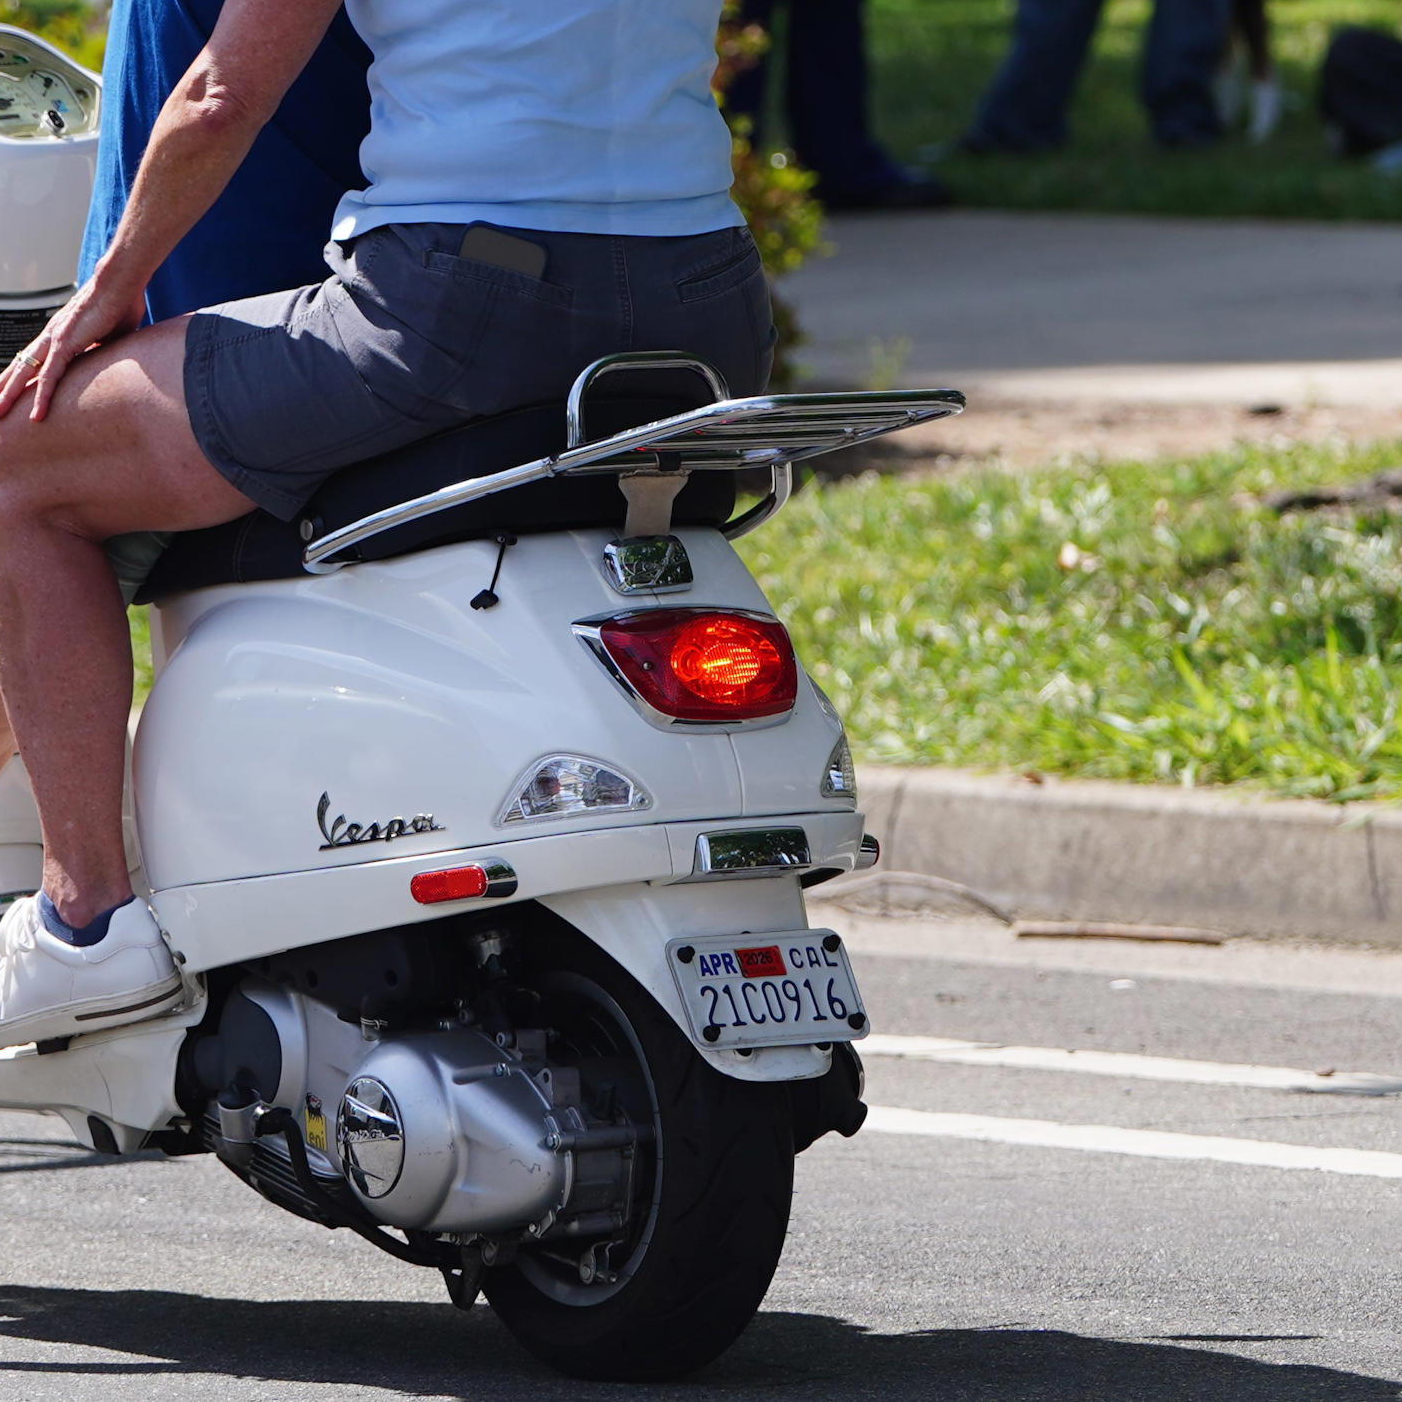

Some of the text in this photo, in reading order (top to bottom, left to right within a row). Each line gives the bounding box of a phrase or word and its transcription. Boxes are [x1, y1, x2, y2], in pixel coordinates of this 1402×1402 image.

[317, 790, 446, 851] Vespa
[699, 945, 838, 977] APR 2026 CAL
[700, 977, 848, 1029] 21C0916
